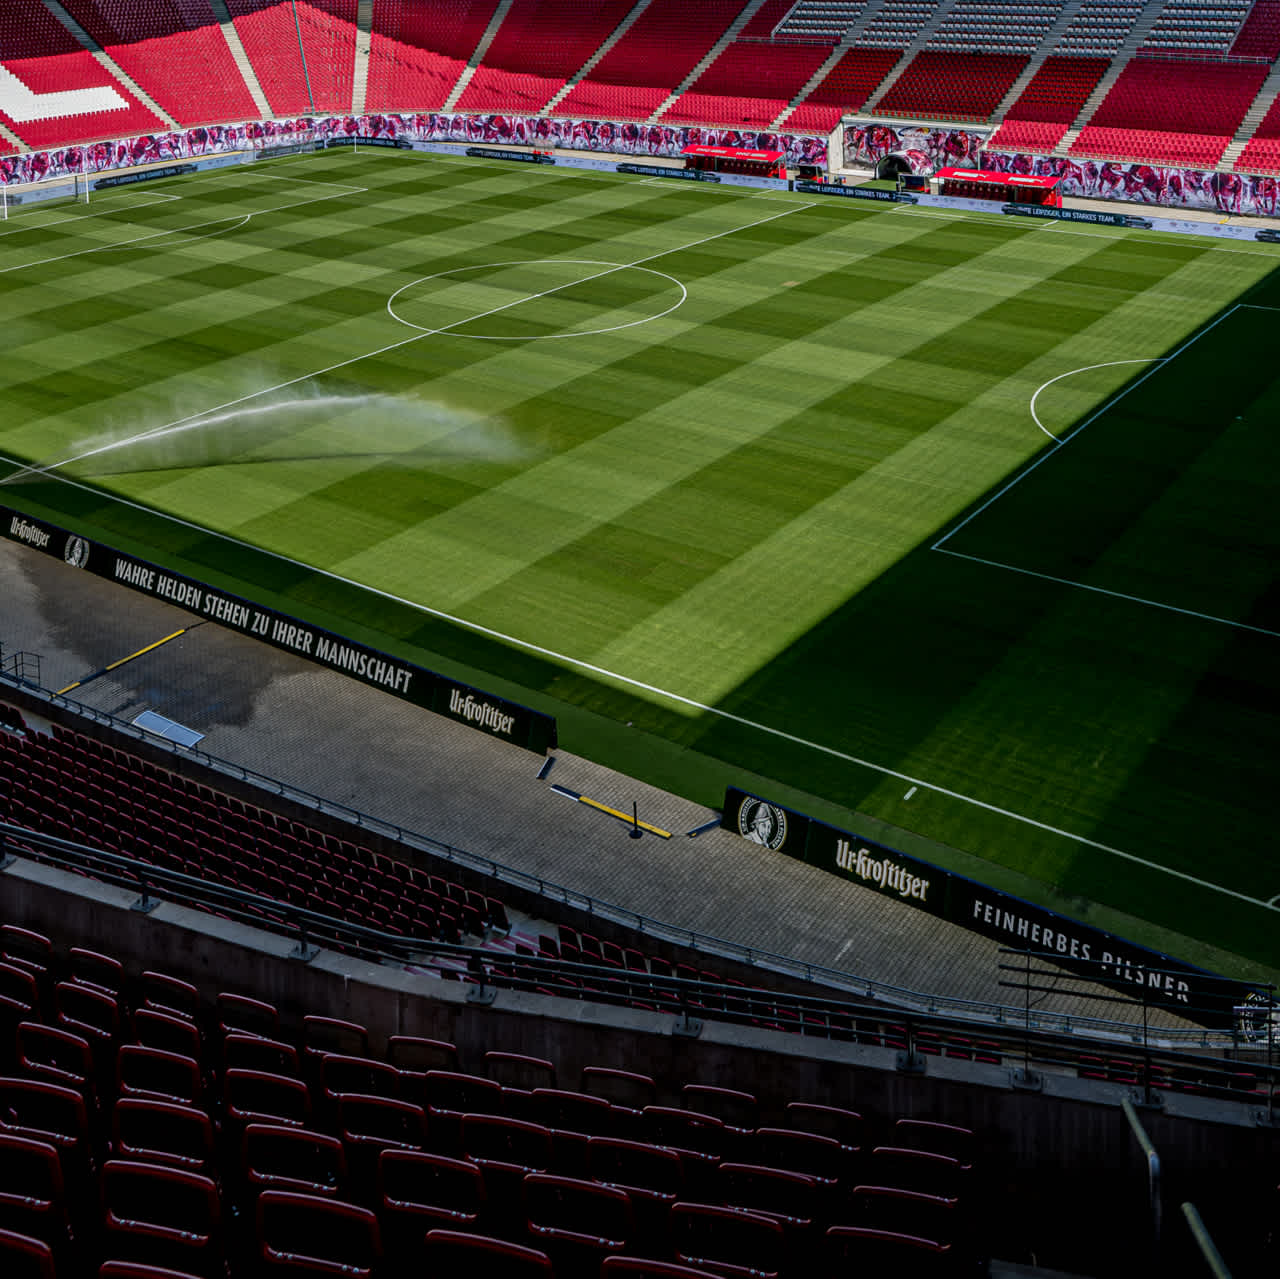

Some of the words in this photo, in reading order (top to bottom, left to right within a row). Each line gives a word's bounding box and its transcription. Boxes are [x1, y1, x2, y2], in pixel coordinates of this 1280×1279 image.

[115, 558, 156, 590] WAHRE
[156, 574, 202, 609] HELDEN
[203, 593, 250, 628] STEHEN
[251, 611, 270, 635] ZU
[272, 620, 313, 654] IHRER
[315, 636, 413, 693] MANNSCHAFT
[972, 899, 1091, 961] FEINHERBES
[1101, 951, 1191, 1004] PILSNER
